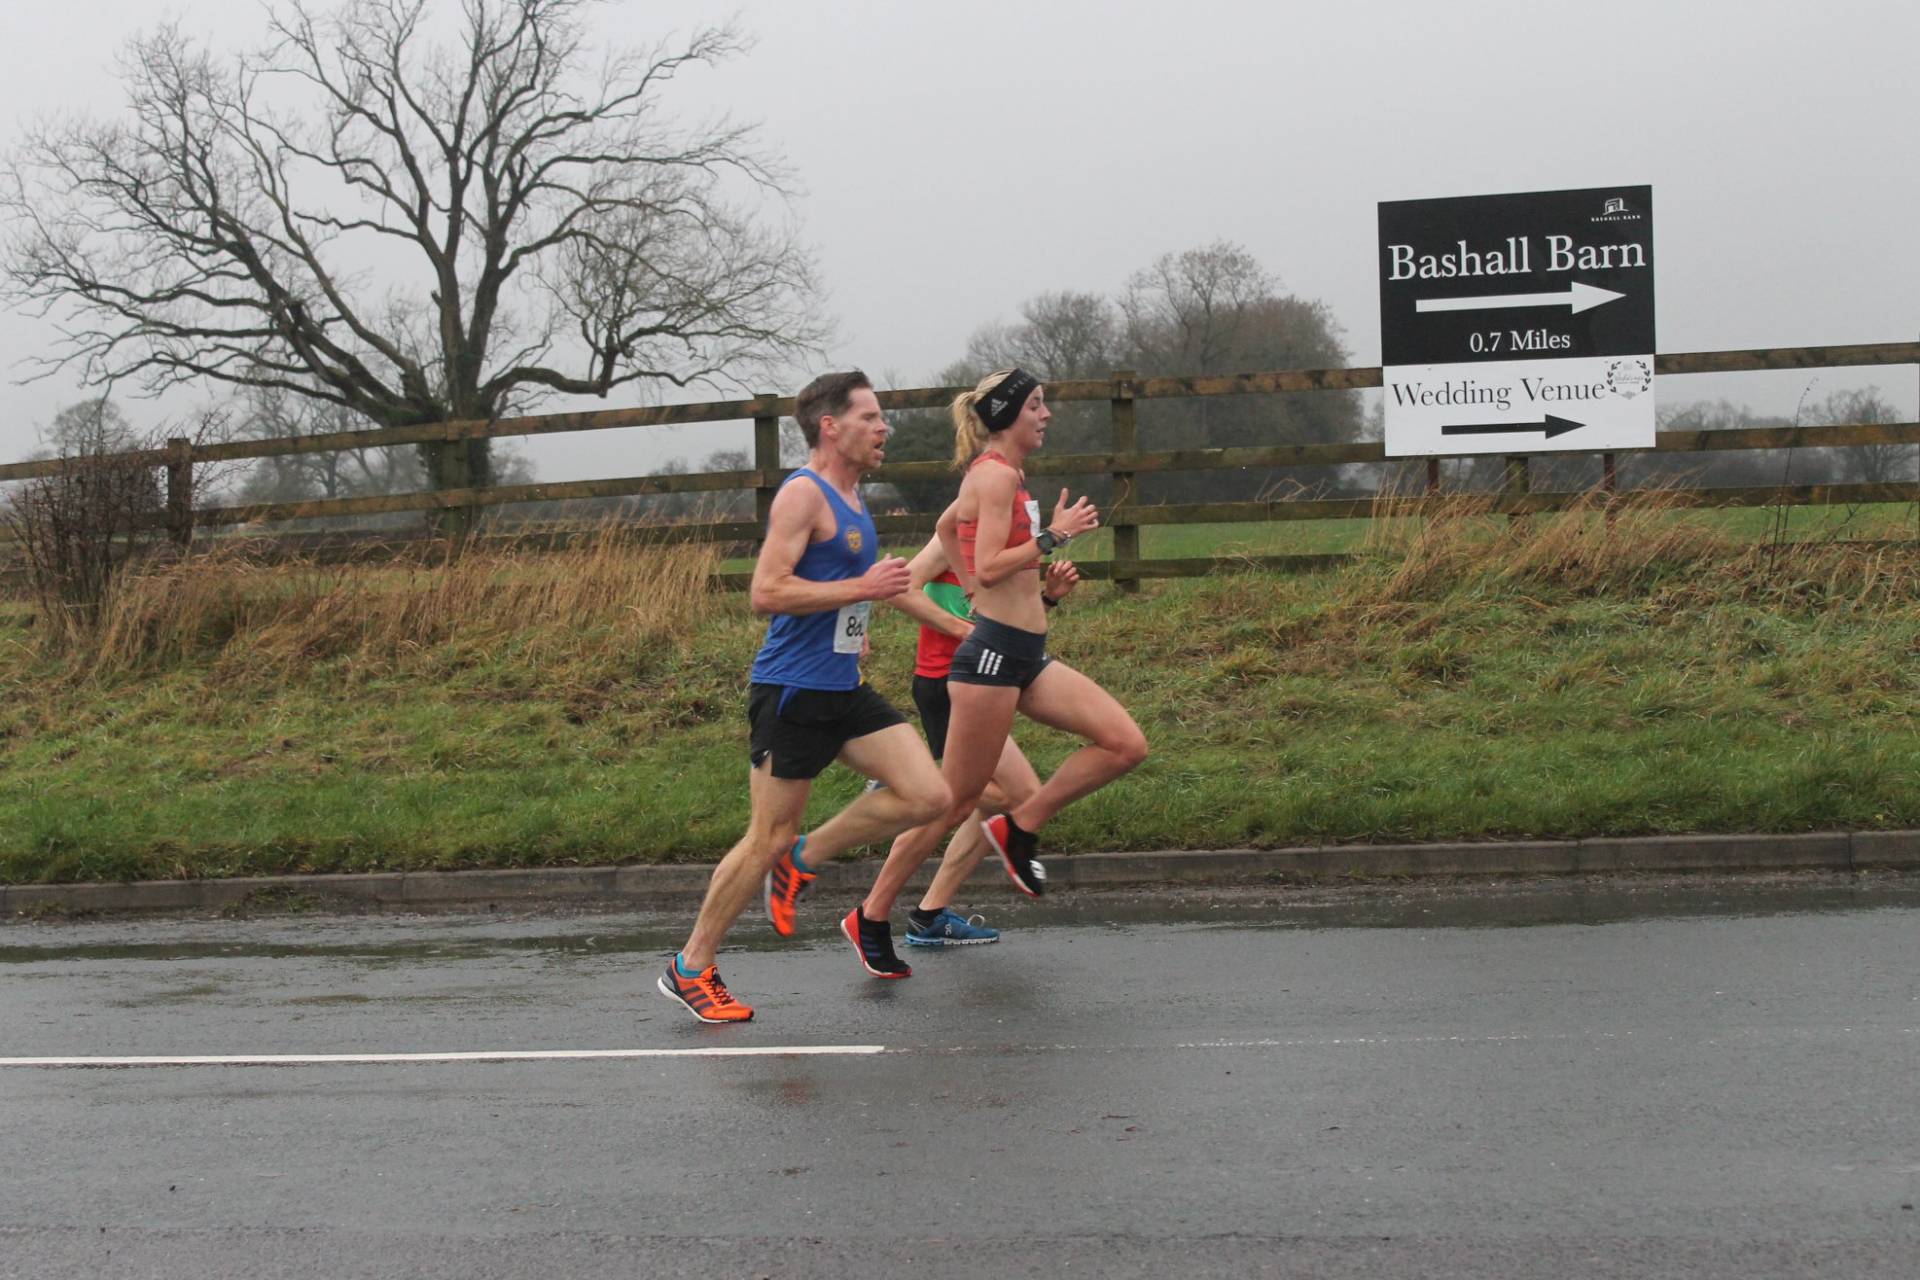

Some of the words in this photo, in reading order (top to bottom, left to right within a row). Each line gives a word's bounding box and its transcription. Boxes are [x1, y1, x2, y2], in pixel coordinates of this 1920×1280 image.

[1388, 236, 1532, 280] Bashall
[1545, 234, 1646, 272] Barn
[1469, 332, 1502, 352] 0.7
[1510, 329, 1571, 351] Miles
[1392, 380, 1512, 411] Wedding
[1520, 377, 1605, 402] Venue
